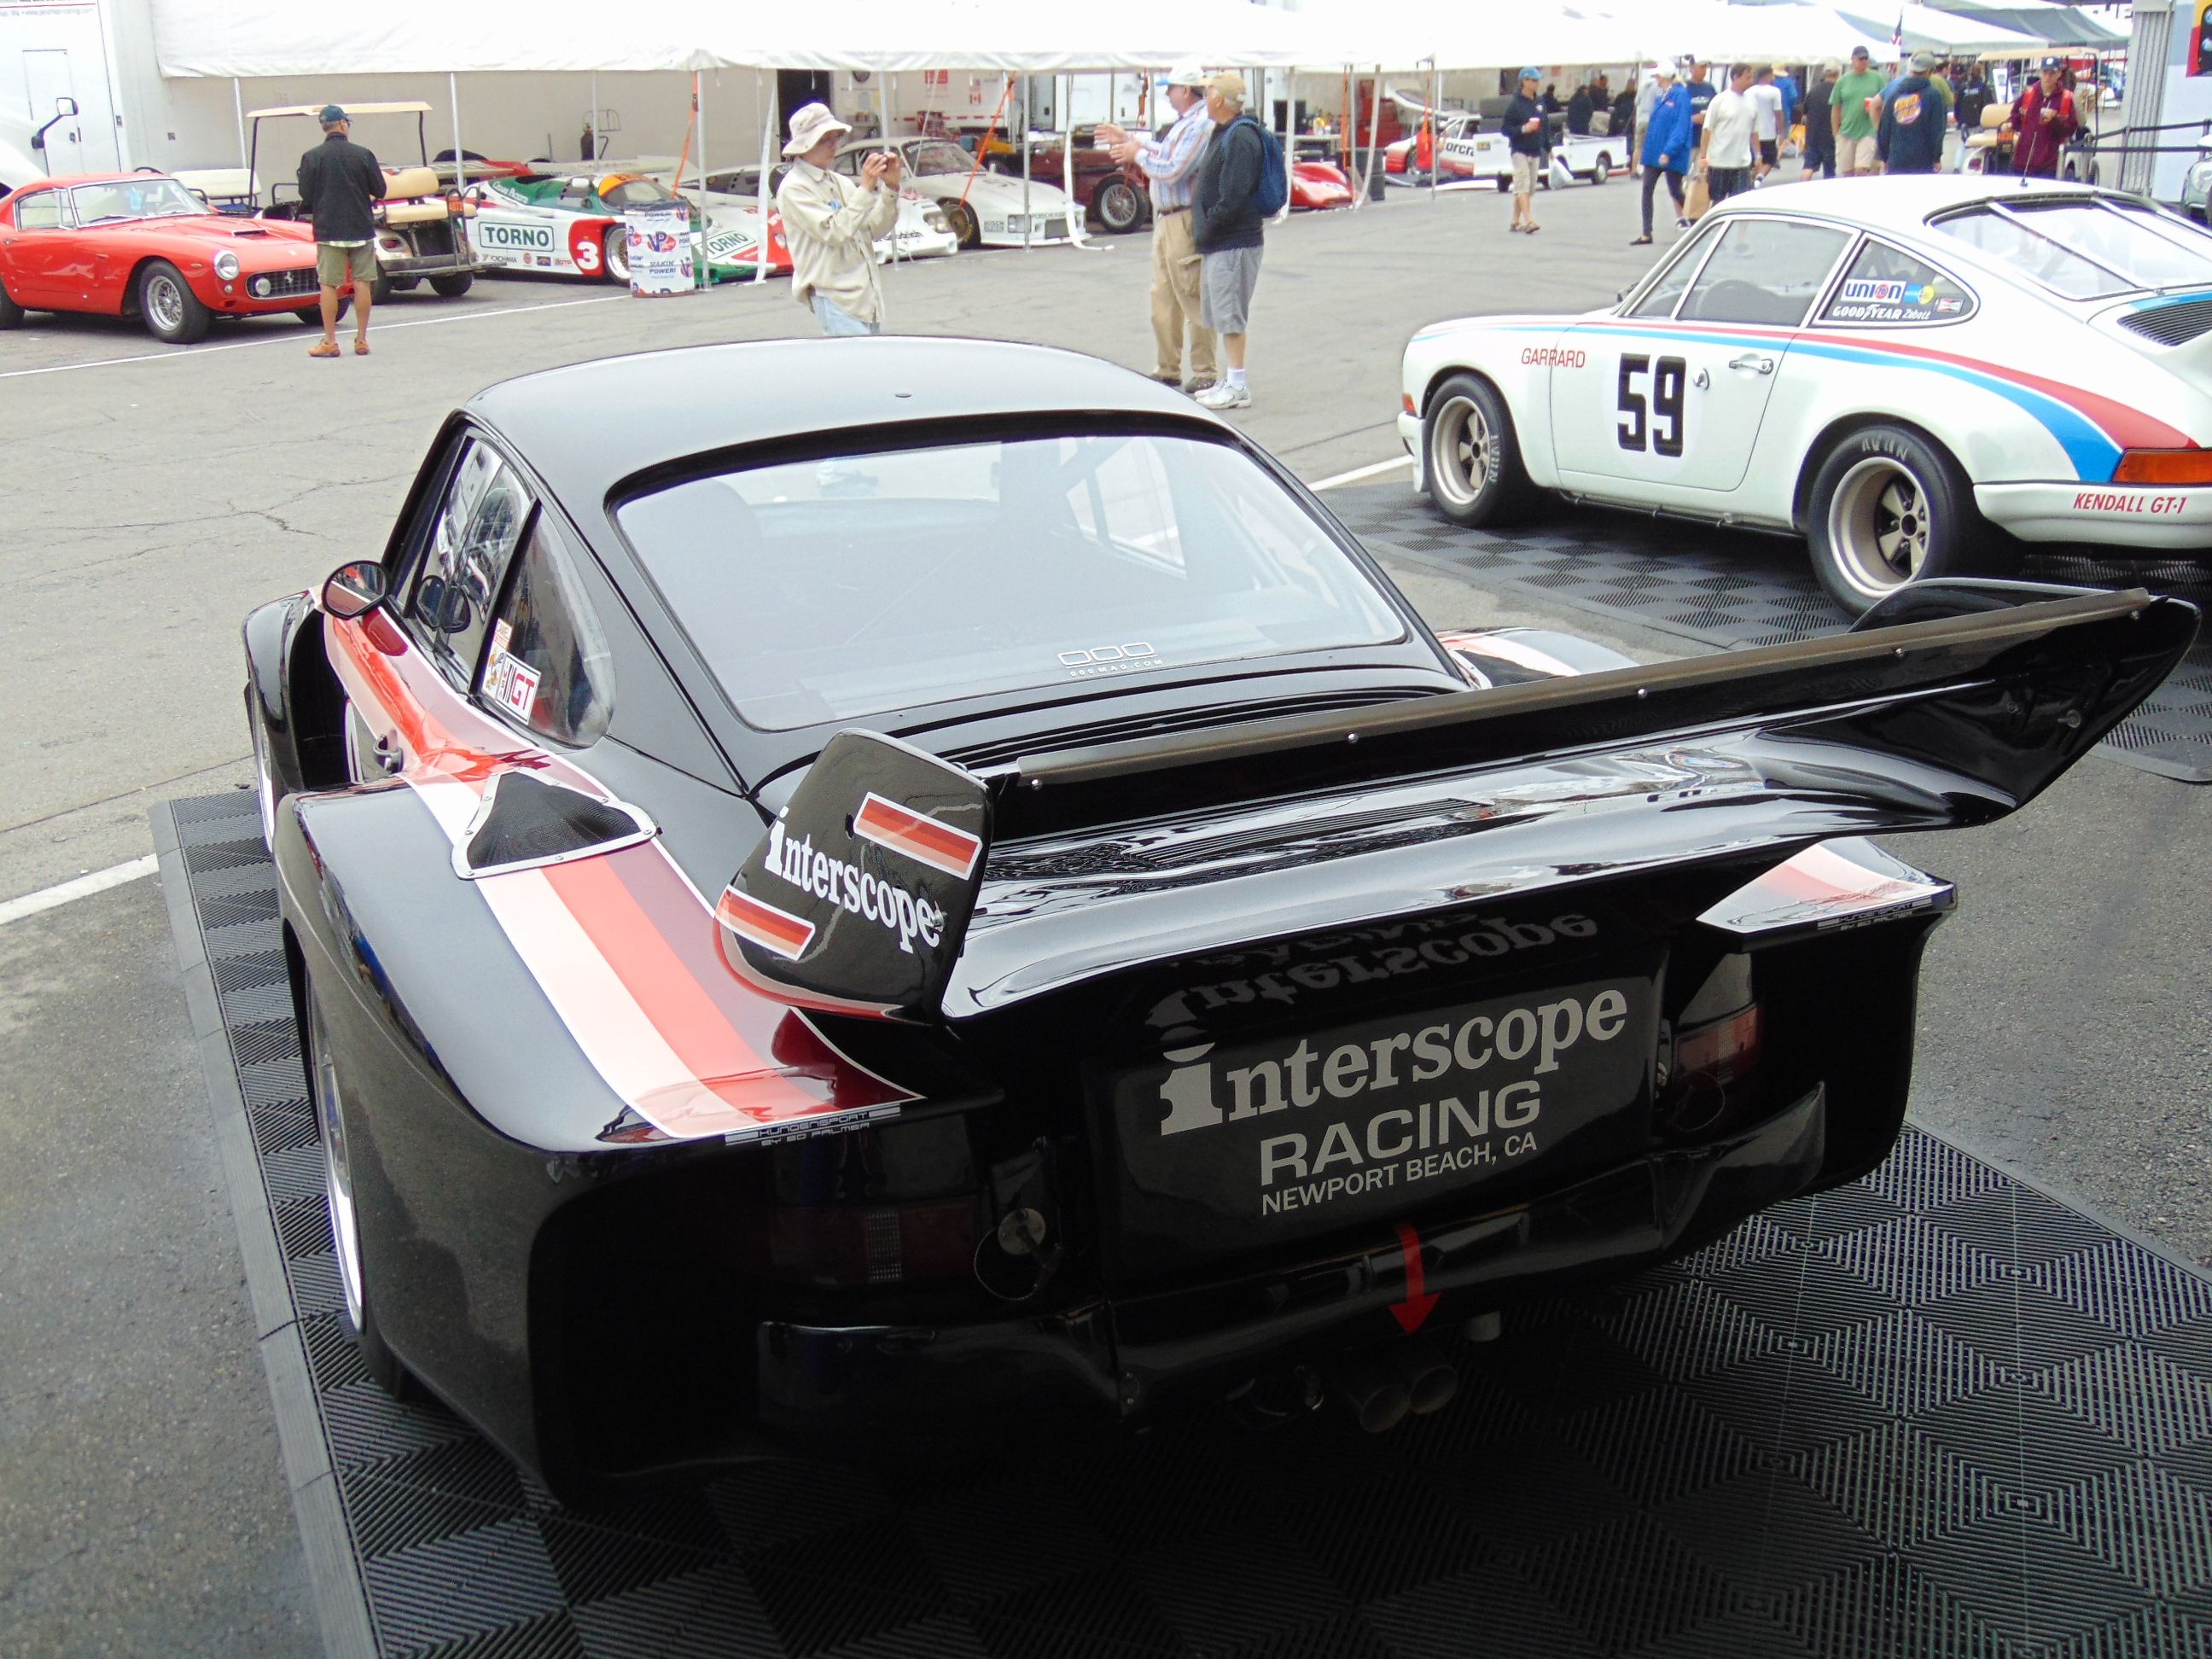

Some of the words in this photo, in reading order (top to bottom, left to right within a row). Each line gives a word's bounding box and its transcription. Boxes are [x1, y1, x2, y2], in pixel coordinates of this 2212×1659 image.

[485, 226, 550, 247] TORNO
[647, 231, 667, 253] VP
[576, 242, 599, 271] 3
[1832, 304, 1903, 320] GOODYEAR
[1521, 347, 1586, 368] GARRARD
[1617, 352, 1687, 457] 59
[2073, 492, 2145, 512] KENDALL
[510, 672, 536, 710] GT
[1260, 1080, 1541, 1186] RACING
[1261, 1163, 1400, 1216] NEWPORT
[1405, 1143, 1497, 1183] BEACH,
[1504, 1132, 1538, 1156] CA
